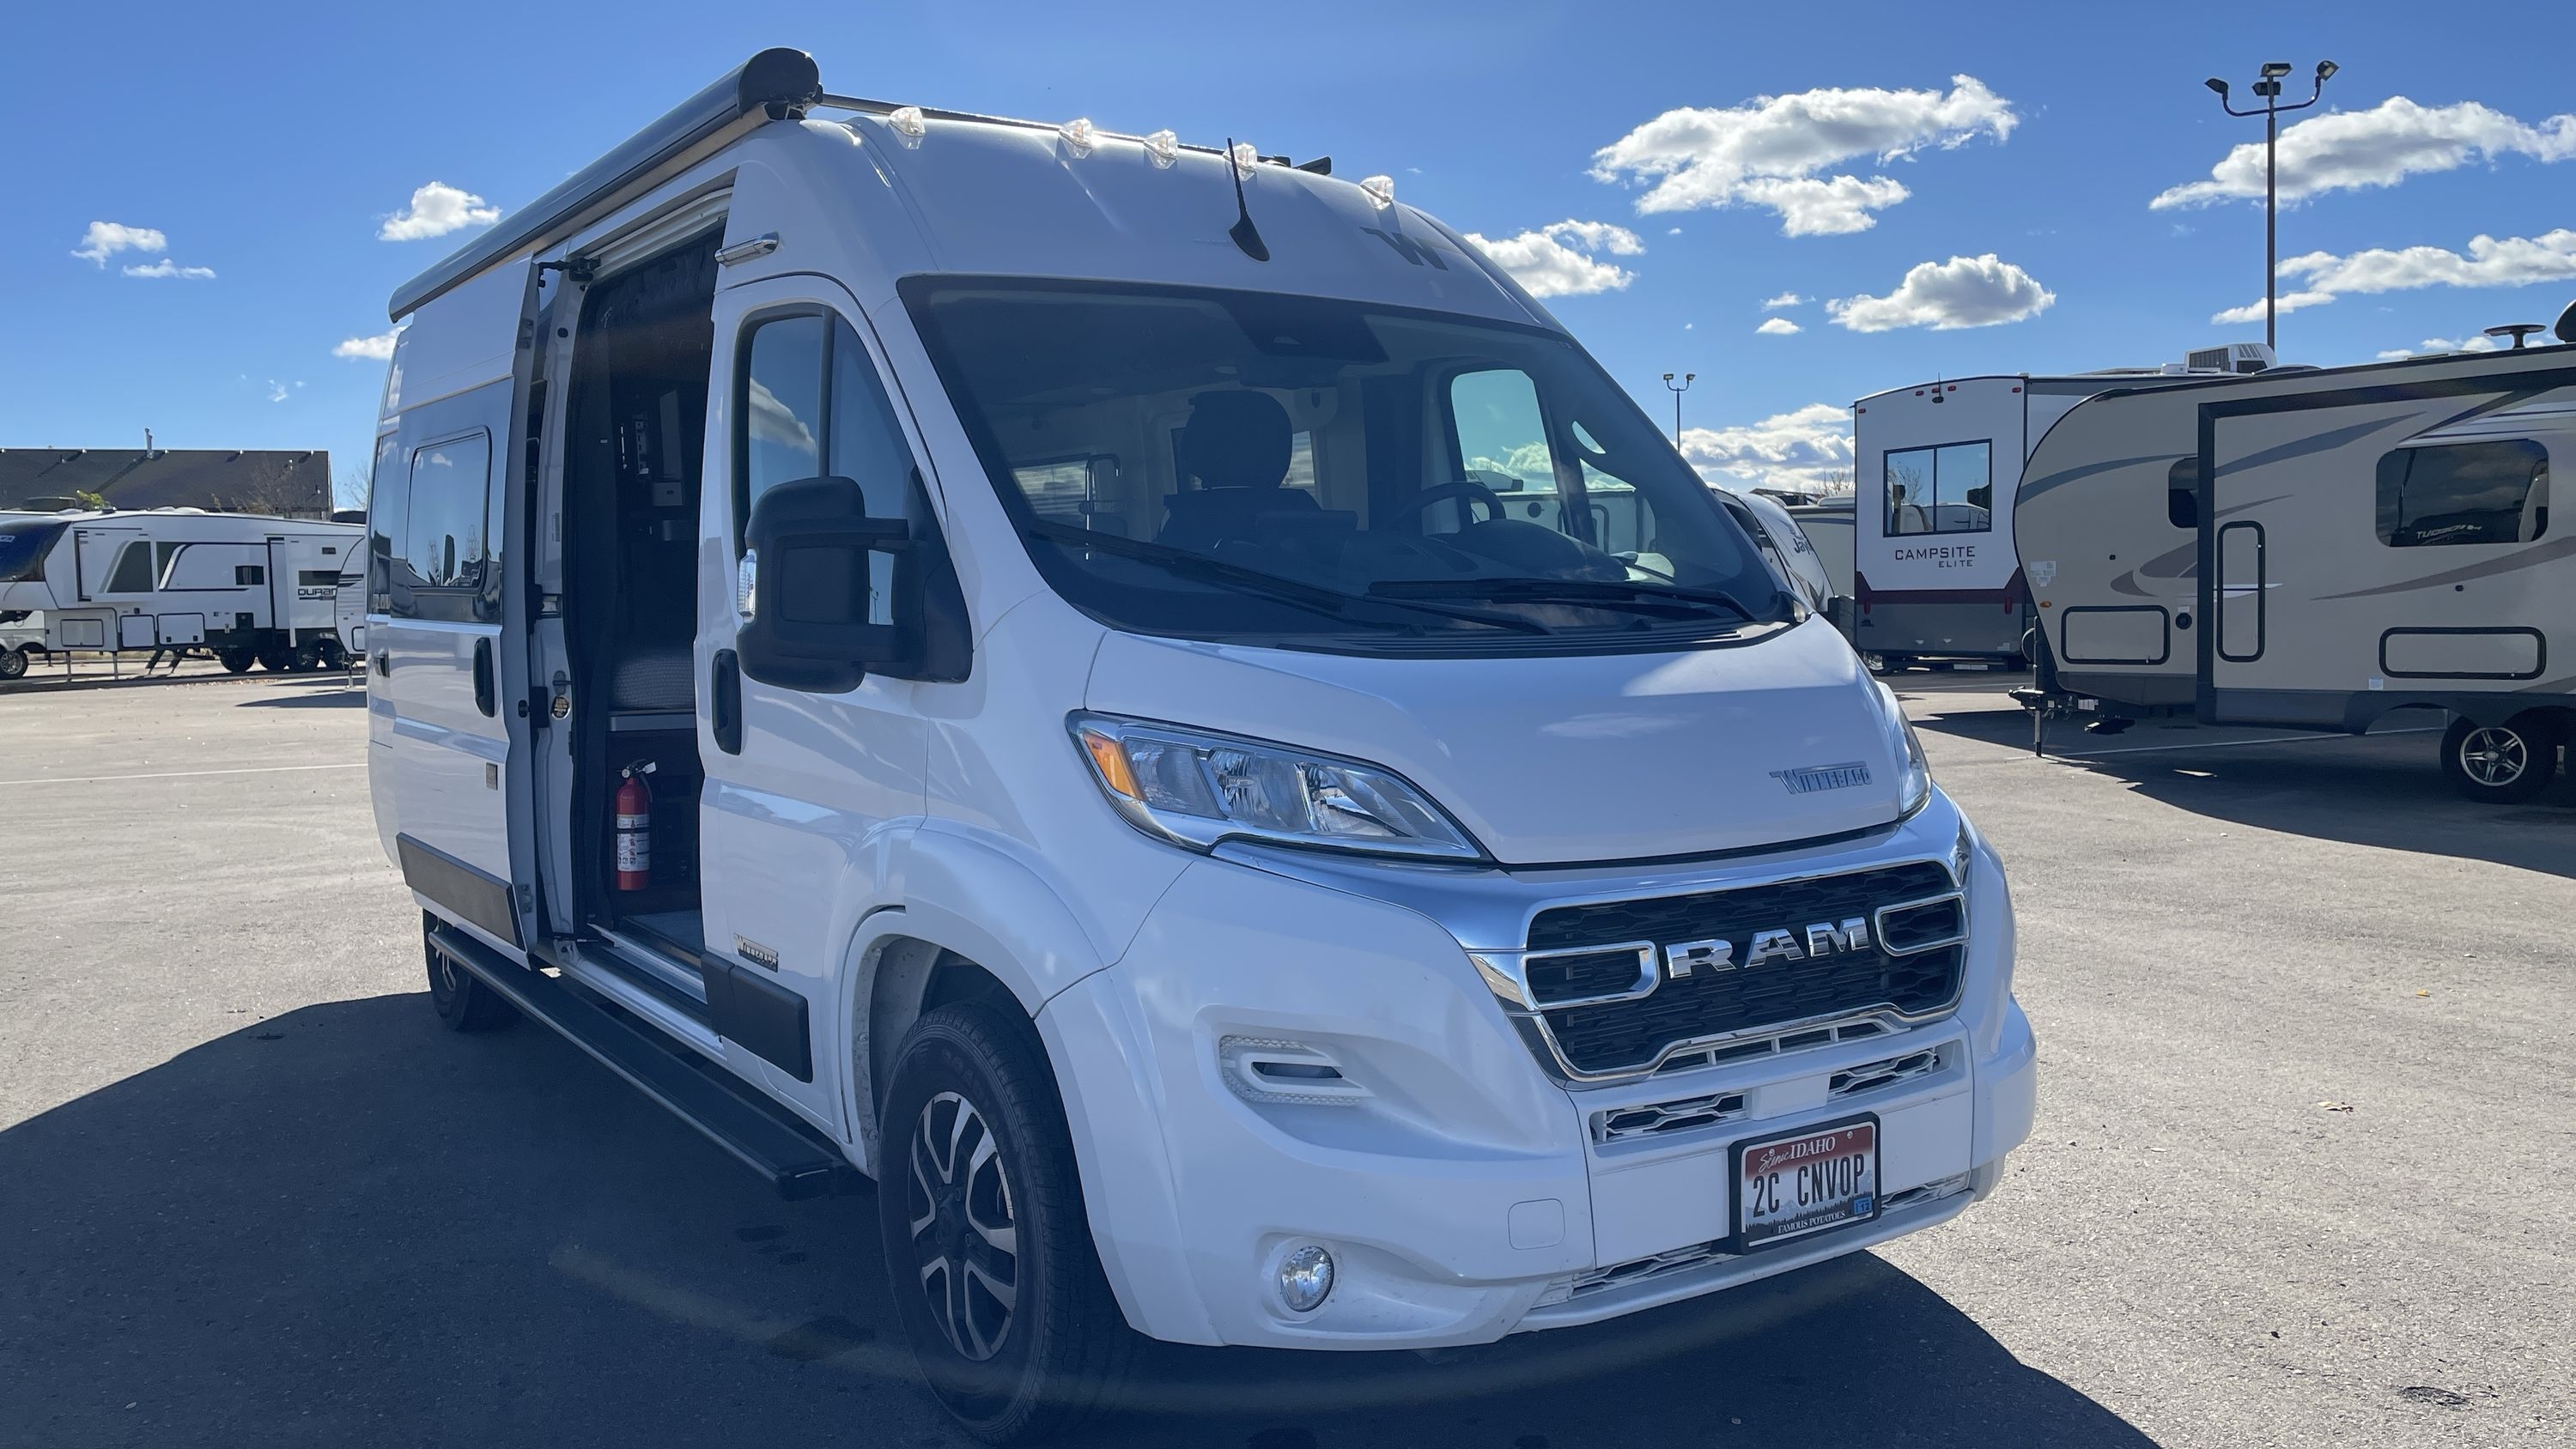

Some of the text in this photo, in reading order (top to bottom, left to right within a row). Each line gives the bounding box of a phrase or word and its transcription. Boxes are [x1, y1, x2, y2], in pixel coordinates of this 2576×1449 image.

[1894, 546, 1976, 561] CAMPSITE
[1938, 559, 1973, 568] ELITE
[1769, 761, 1873, 795] WINNEBAGO
[1665, 917, 1870, 979] RAM
[1789, 1136, 1836, 1160] IDAHO
[1753, 1172, 1780, 1218] 2C
[1777, 1210, 1846, 1234] FAMOUS POTATOES
